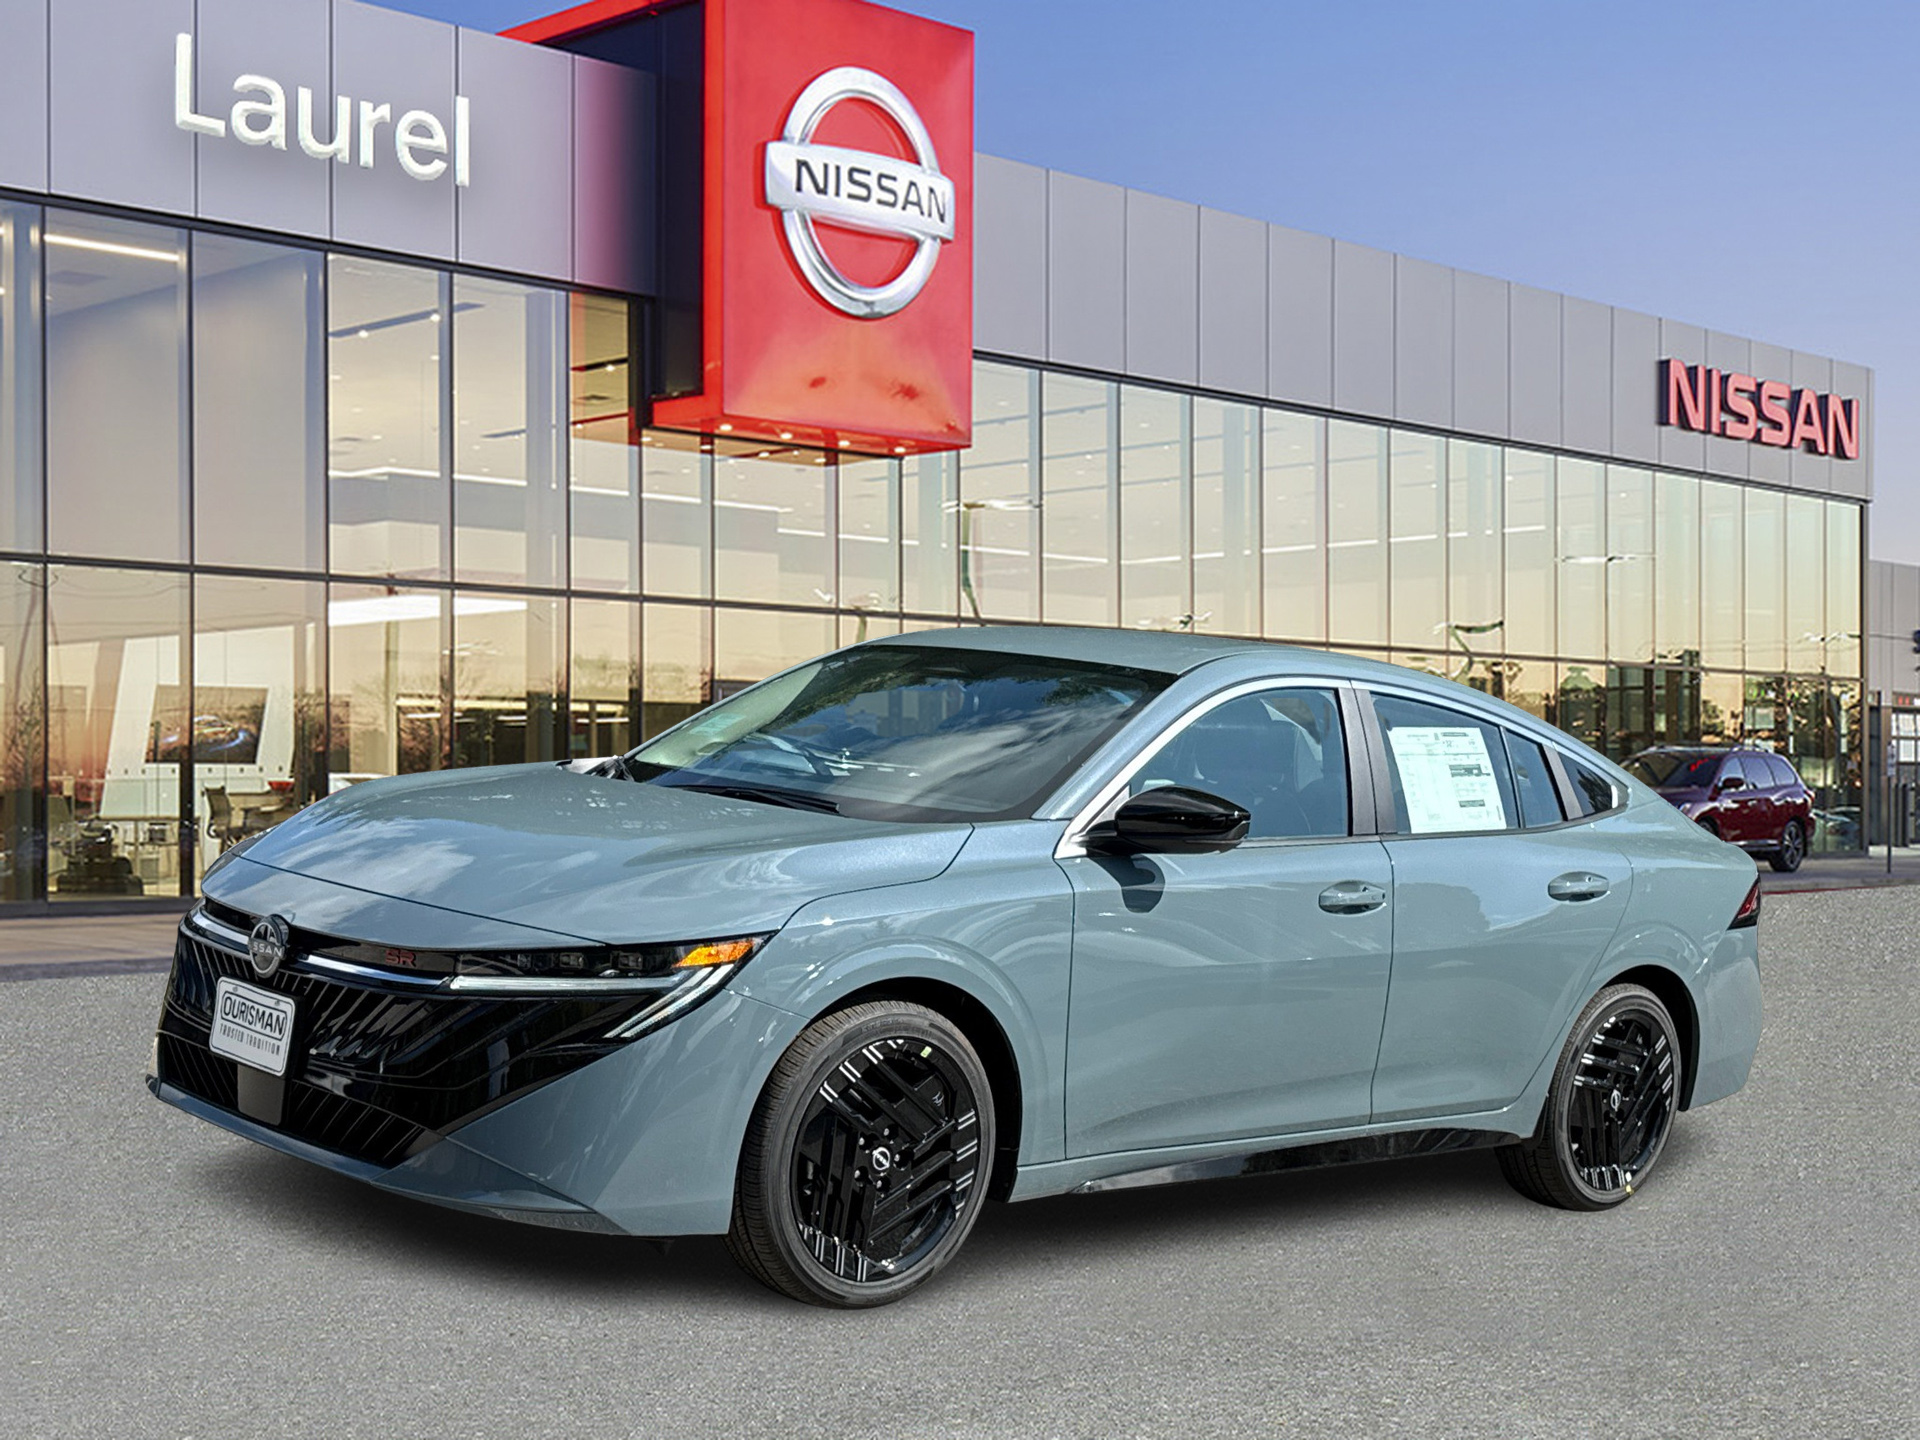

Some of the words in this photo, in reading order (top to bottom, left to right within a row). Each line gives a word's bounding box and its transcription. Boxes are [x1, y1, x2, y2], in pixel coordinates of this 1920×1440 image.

[175, 33, 469, 187] Laurel
[796, 159, 946, 223] NISSAN
[1658, 359, 1859, 460] NISSAN
[252, 941, 283, 957] SSAN
[386, 949, 415, 968] SR
[223, 996, 285, 1036] OURISMAN
